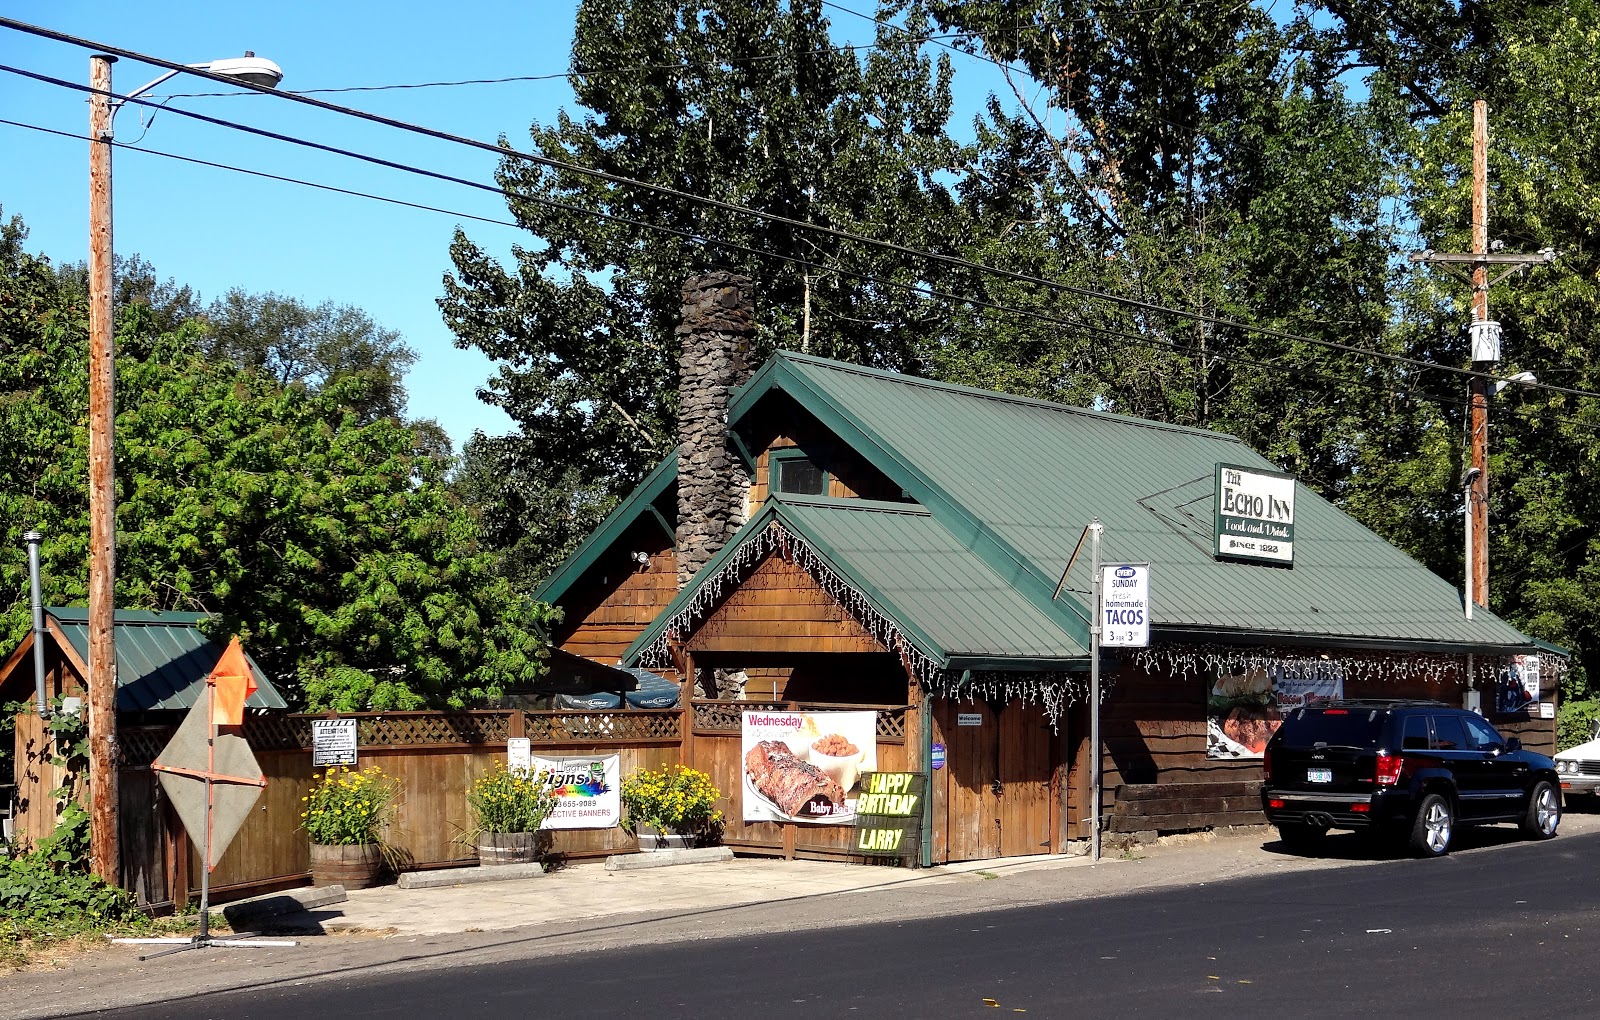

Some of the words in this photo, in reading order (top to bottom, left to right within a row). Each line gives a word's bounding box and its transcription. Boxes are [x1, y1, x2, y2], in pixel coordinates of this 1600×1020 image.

[1223, 487, 1264, 518] ECHO
[1266, 494, 1291, 521] INN
[1225, 518, 1247, 533] Food
[1247, 523, 1264, 535] and
[1265, 523, 1291, 538] Drink
[1112, 579, 1138, 588] SUNDAY
[1105, 599, 1143, 608] homemade
[1105, 609, 1143, 625] TACOS
[1109, 630, 1115, 641] 3
[748, 714, 803, 729] Wednesday
[320, 727, 348, 735] ATTENTION
[869, 773, 914, 794] HAPPY
[810, 801, 831, 816] Baby
[857, 792, 918, 816] BIRTHDAY
[578, 808, 611, 818] BANNERS
[858, 828, 903, 851] LARRY
